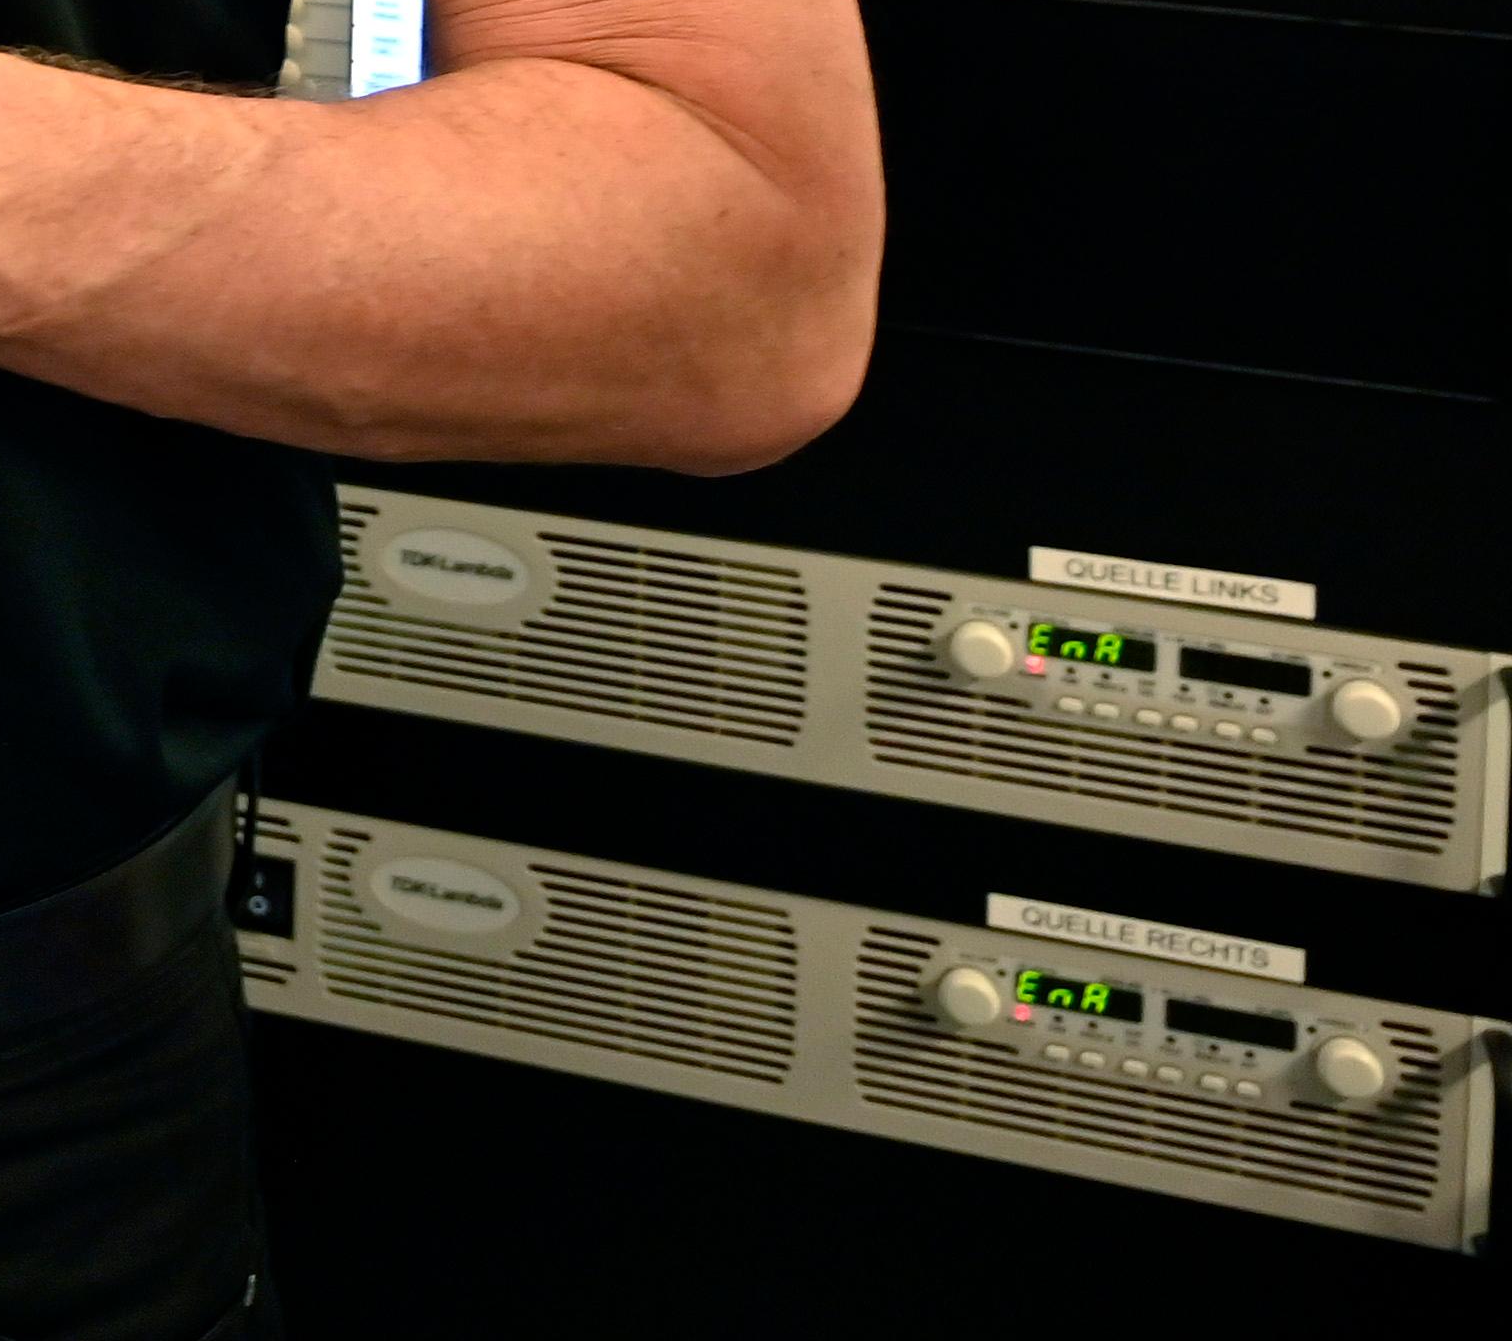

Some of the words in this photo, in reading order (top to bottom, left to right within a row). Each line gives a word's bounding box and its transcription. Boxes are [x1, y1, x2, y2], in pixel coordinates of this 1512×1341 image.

[1064, 557, 1182, 593] QUELLE
[1192, 579, 1280, 605] LINKS
[1021, 905, 1137, 943] QUELLE
[1147, 929, 1270, 969] RECHTS
